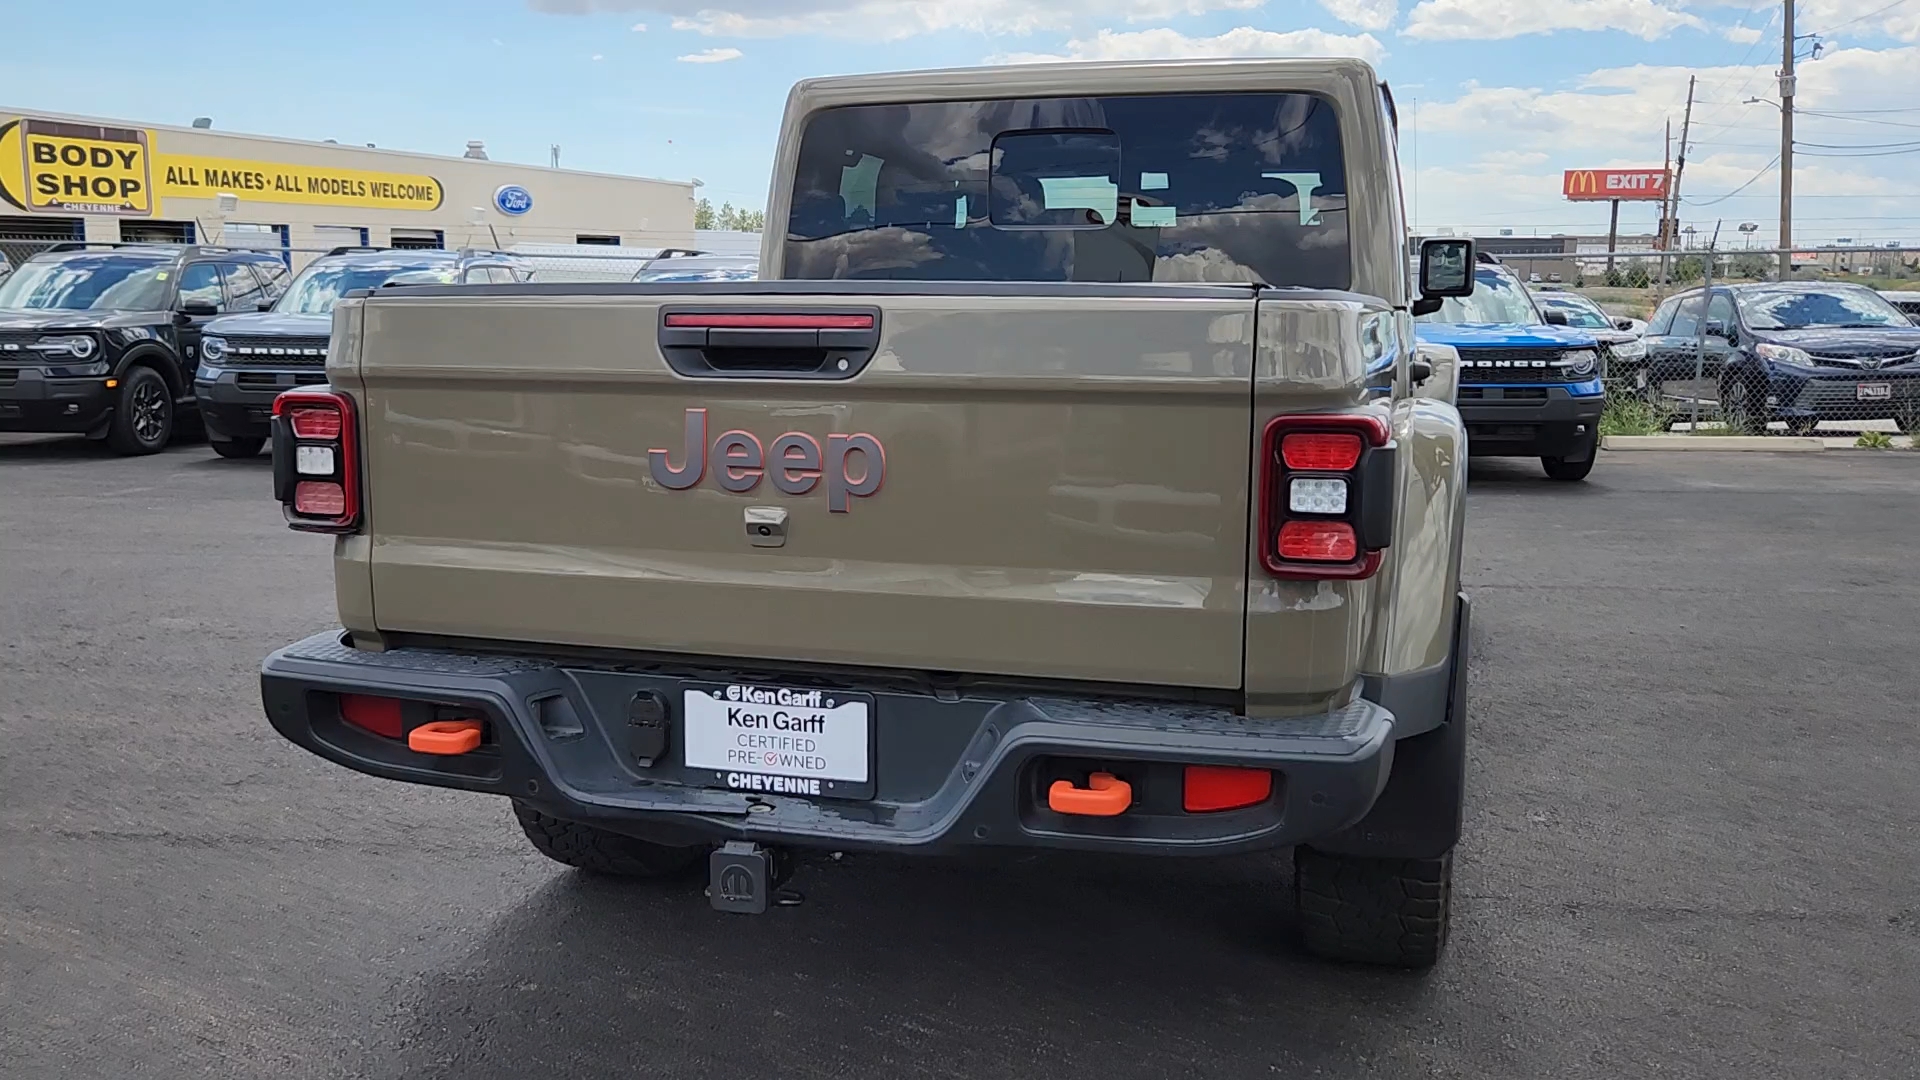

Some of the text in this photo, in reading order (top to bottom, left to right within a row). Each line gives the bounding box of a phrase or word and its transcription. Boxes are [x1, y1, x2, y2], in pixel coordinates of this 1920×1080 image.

[32, 142, 137, 170] BODY
[36, 173, 141, 198] SHOP
[166, 166, 433, 201] ALL MAKES ALL MODELS WELCOME
[1606, 174, 1664, 189] EXIT 7
[63, 203, 121, 213] CHEYENNE
[506, 191, 528, 209] Ford
[1460, 360, 1546, 368] RONCO
[648, 407, 886, 513] Jeep
[741, 686, 822, 708] Ken Garff
[727, 707, 825, 734] Ken Garff
[737, 733, 816, 753] CERTIFIED
[727, 772, 821, 796] CHEYENNE
